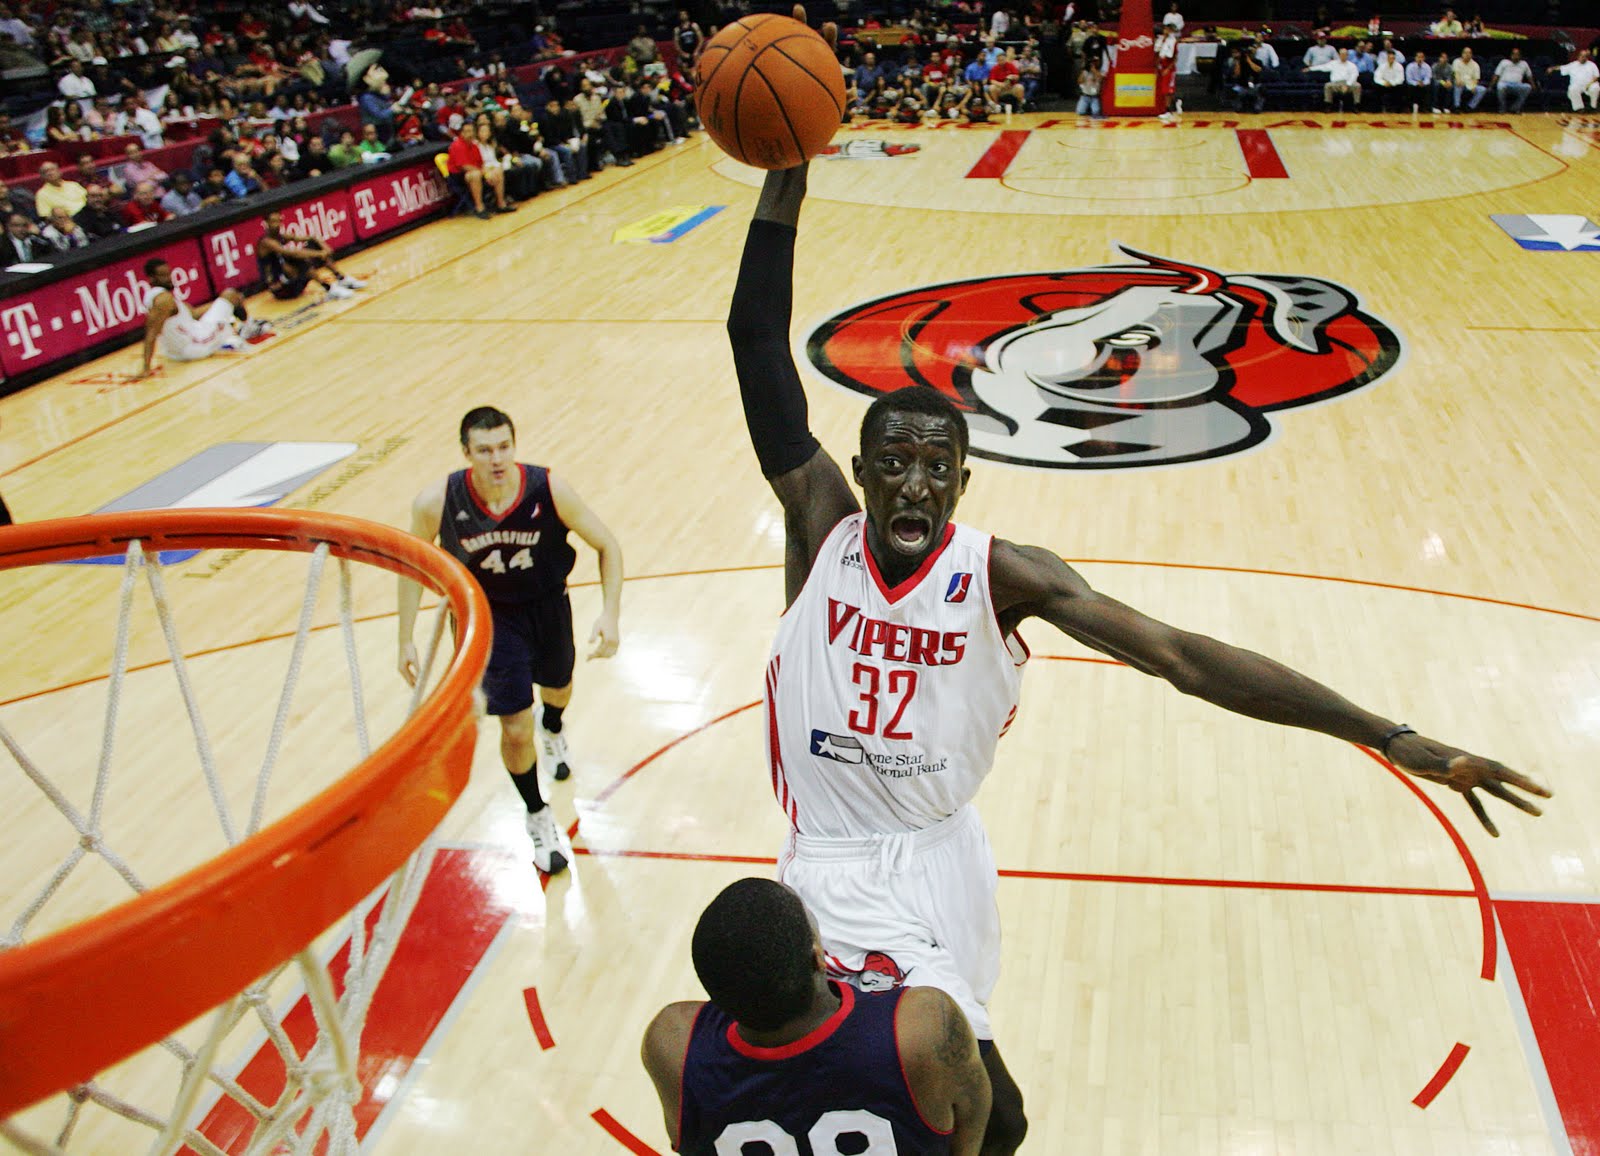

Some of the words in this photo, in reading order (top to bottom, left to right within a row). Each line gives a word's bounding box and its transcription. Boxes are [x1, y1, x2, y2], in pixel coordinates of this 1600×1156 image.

[480, 548, 534, 574] 44
[828, 597, 968, 666] VIPERS
[848, 662, 917, 740] 32
[895, 753, 924, 766] Star
[917, 758, 948, 776] Bank
